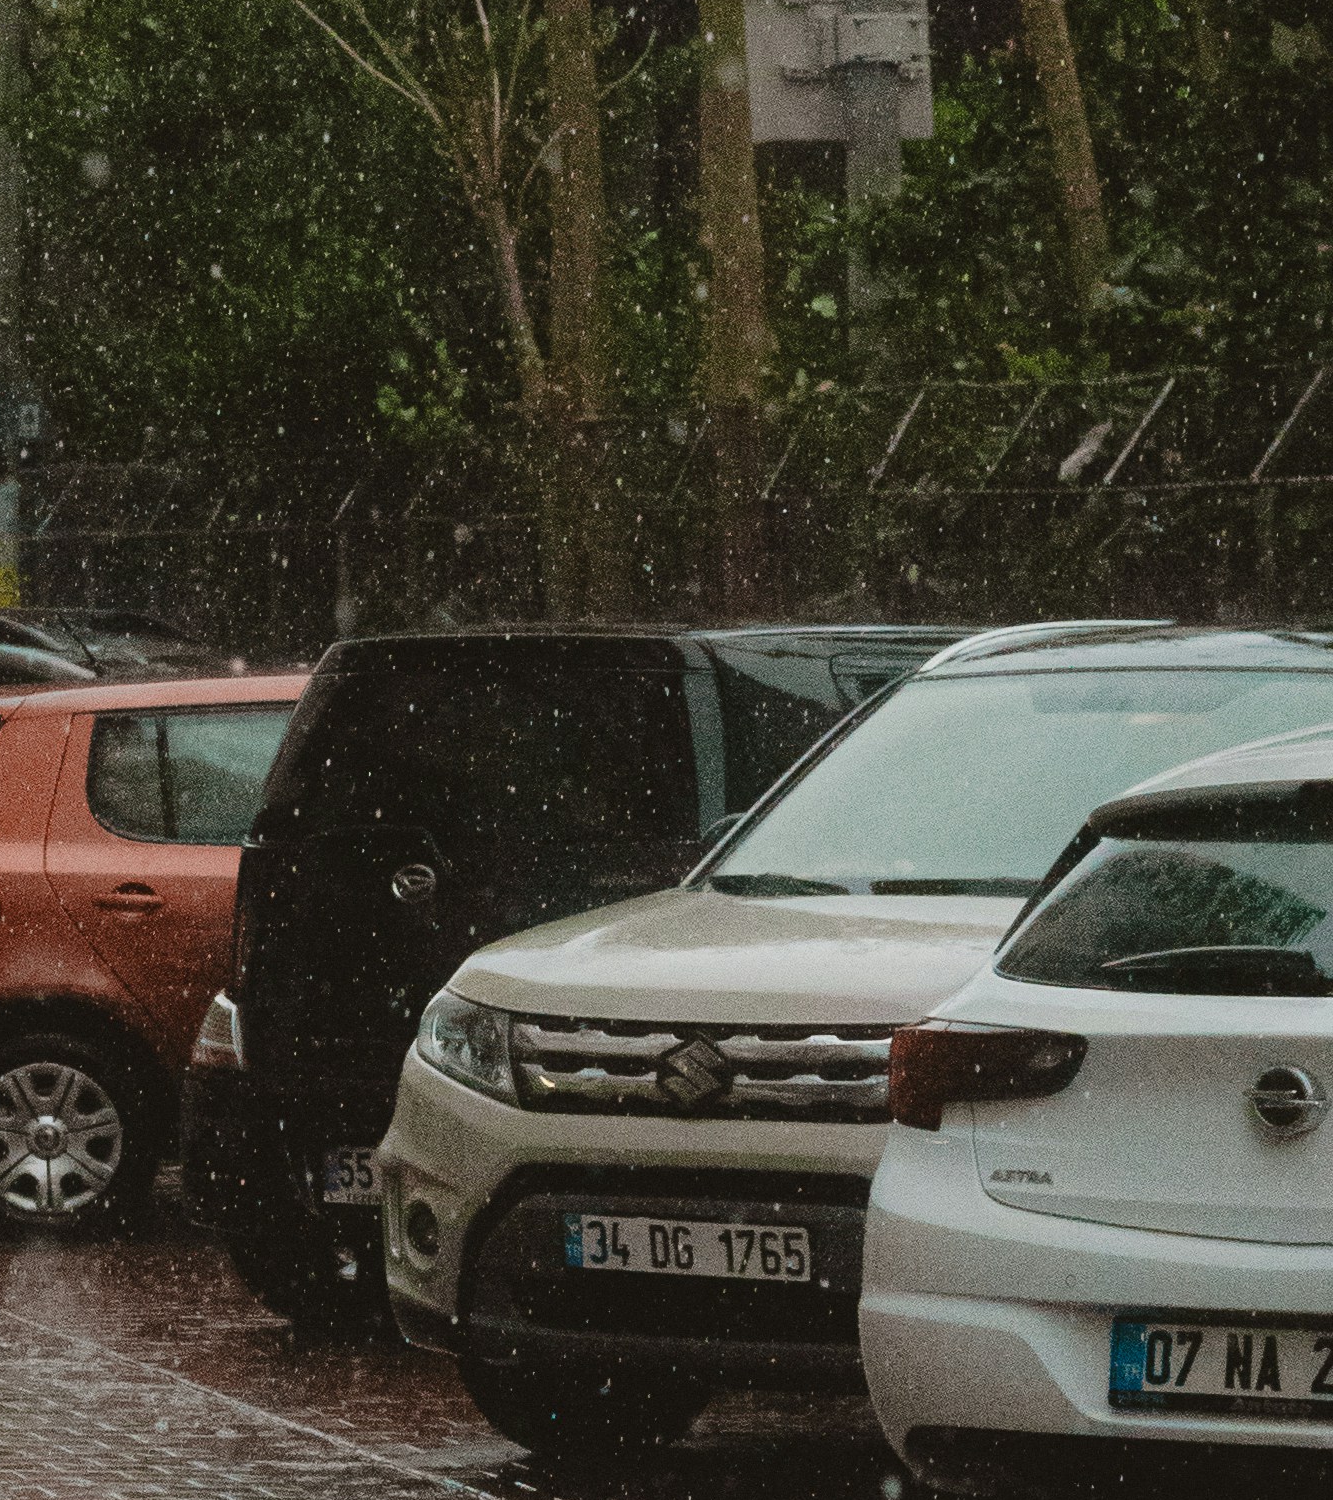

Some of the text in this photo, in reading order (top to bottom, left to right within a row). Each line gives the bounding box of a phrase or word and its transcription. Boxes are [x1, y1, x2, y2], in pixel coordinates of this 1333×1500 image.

[339, 1151, 373, 1189] 55
[587, 1220, 805, 1276] 34 DG 1765
[1145, 1329, 1204, 1387] 07
[1224, 1332, 1282, 1392] NA
